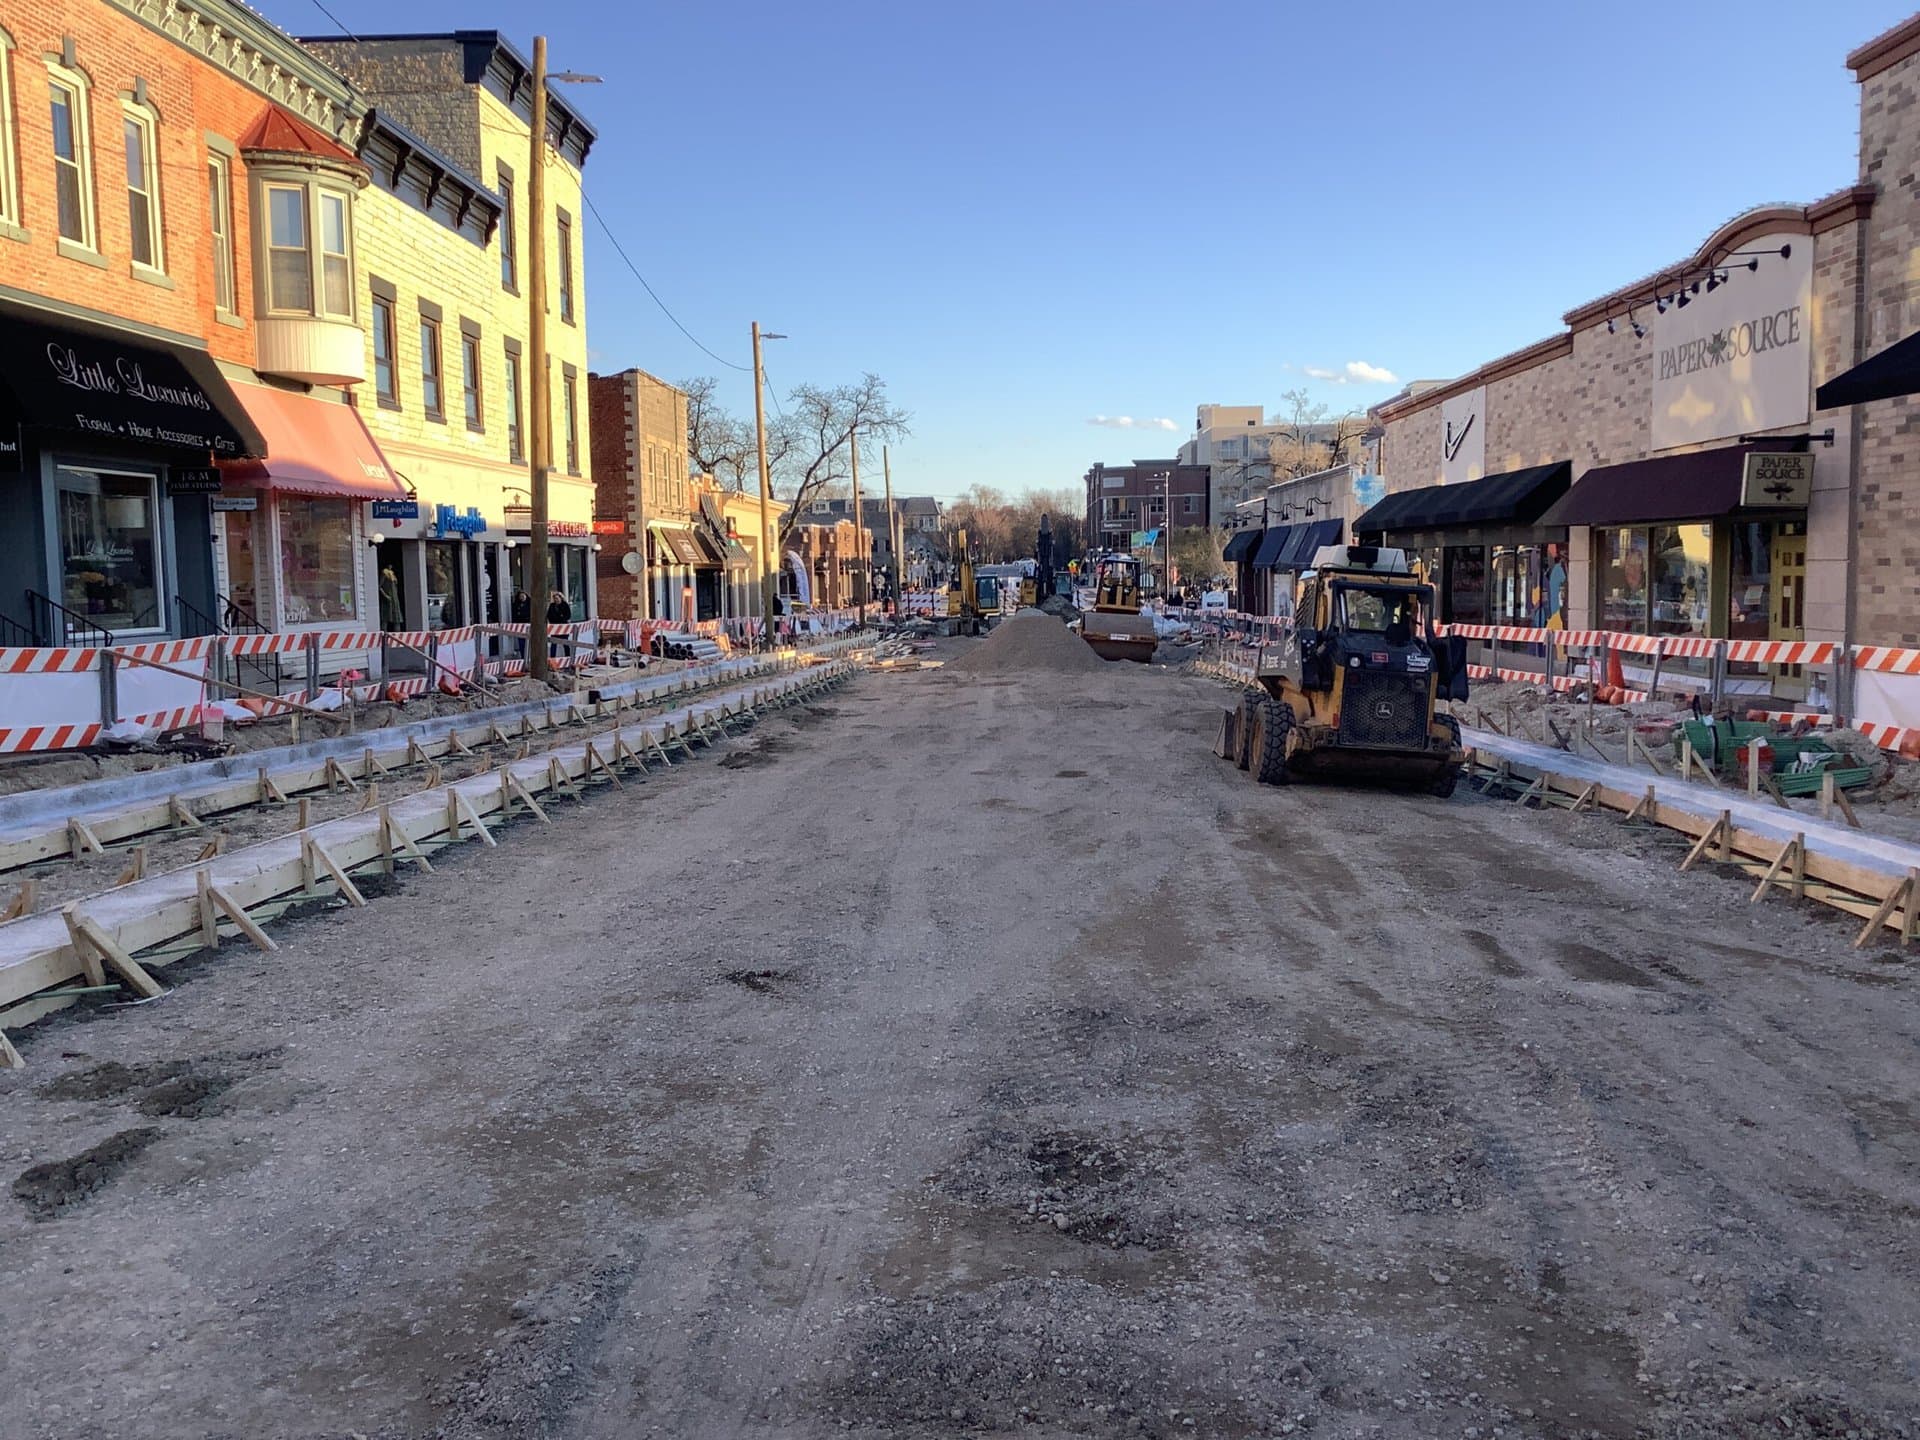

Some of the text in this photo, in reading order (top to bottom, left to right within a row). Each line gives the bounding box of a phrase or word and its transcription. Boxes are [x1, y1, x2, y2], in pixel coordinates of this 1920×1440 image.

[1659, 306, 1801, 380] PAPER SOURCE
[47, 342, 211, 411] Little Luxuries
[76, 414, 235, 451] FLORAL HOME ACCESSORIES GIFTS
[1756, 468, 1804, 479] SOURCE
[1762, 457, 1801, 468] PAPER
